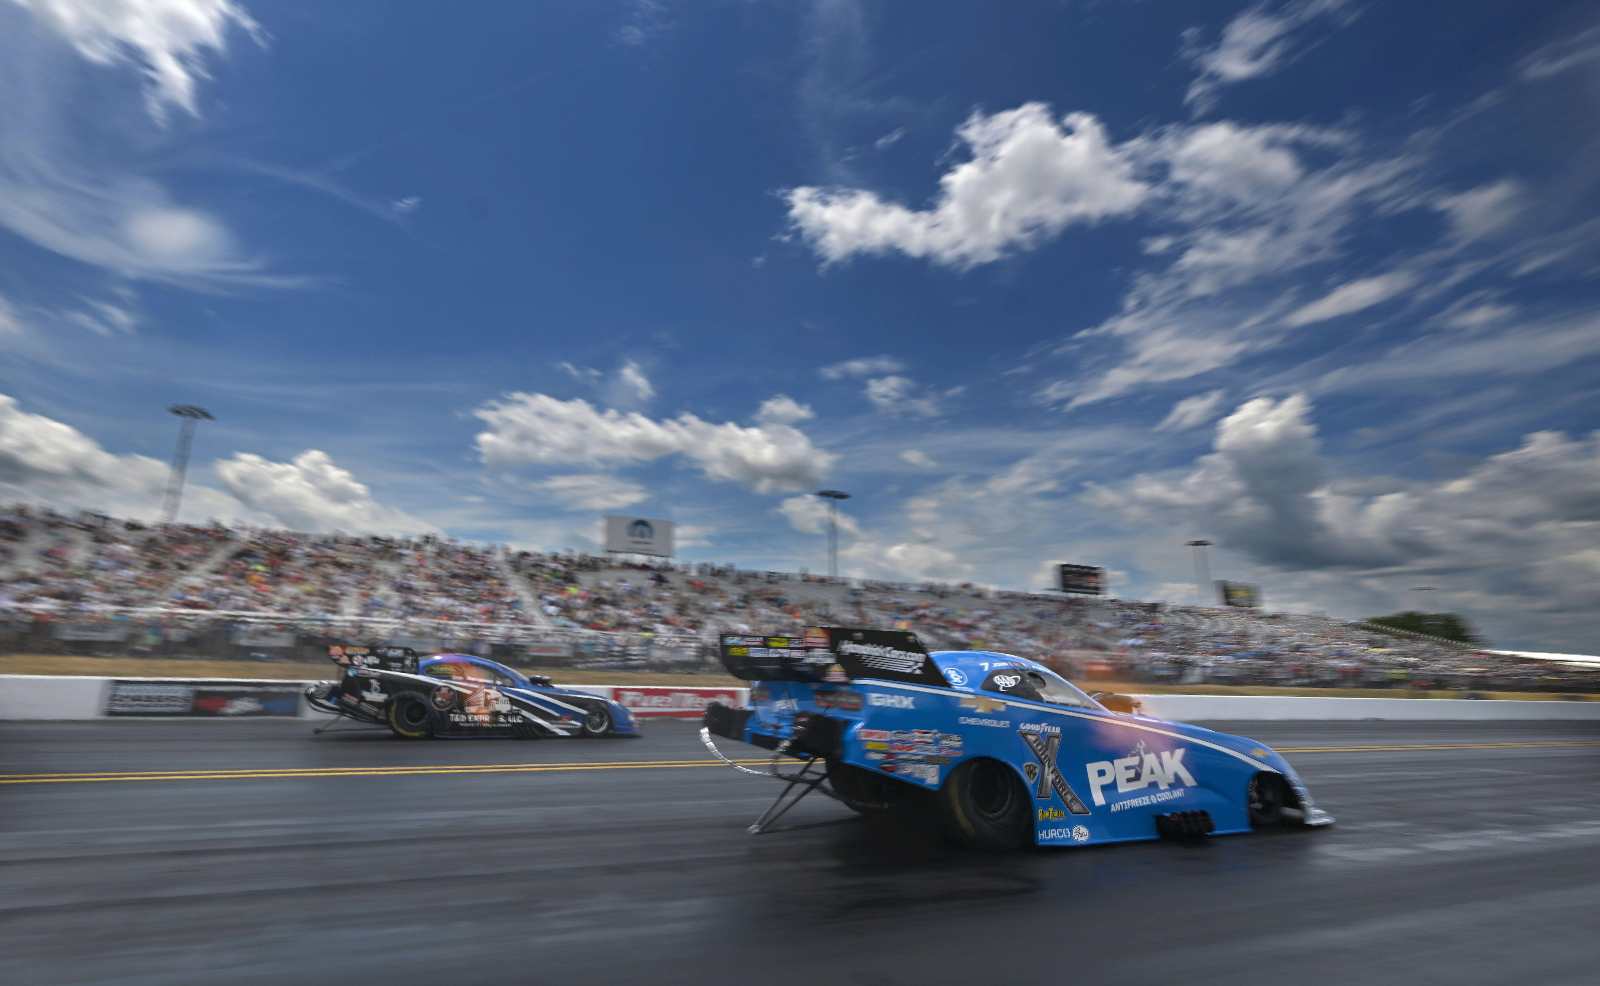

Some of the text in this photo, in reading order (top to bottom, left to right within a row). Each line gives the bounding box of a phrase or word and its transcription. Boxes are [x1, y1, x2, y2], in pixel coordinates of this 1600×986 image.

[1019, 722, 1061, 734] GOODYEAR
[1086, 747, 1198, 807] PEAK
[1110, 794, 1150, 814] ANTIFREEZE
[1157, 788, 1185, 803] COOLANT
[1037, 827, 1071, 841] HURCO
